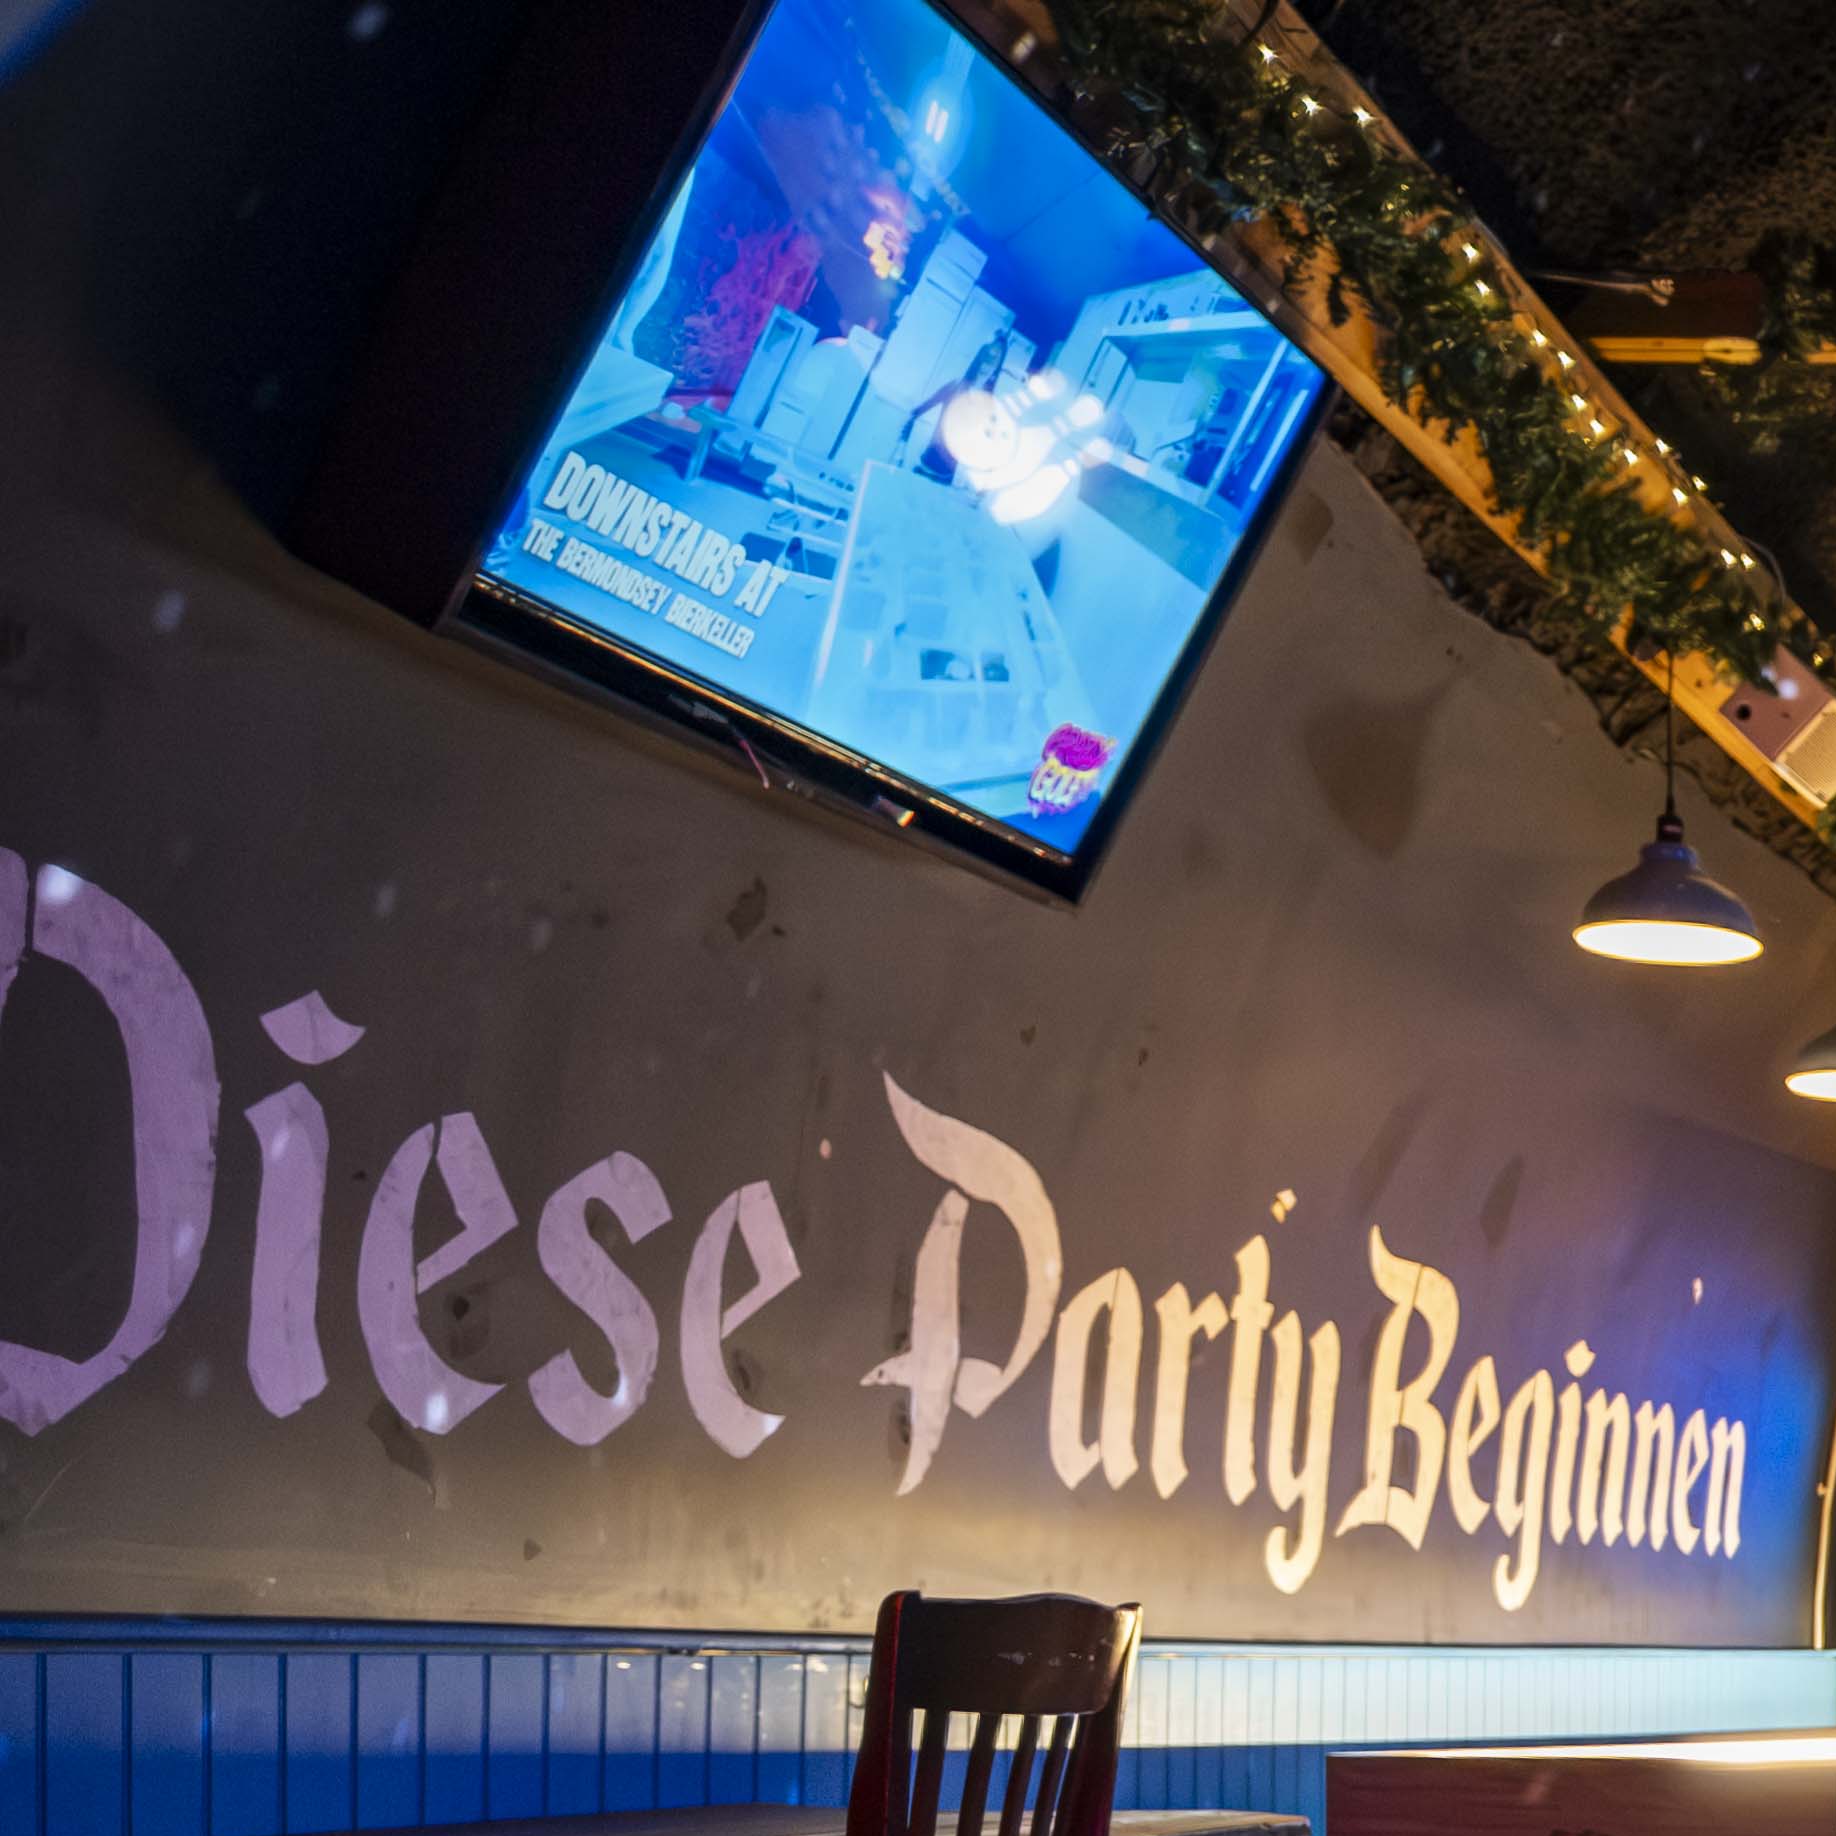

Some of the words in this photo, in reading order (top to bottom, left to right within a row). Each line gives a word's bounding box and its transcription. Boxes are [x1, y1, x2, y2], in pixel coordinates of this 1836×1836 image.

[523, 518, 565, 563] THE
[556, 537, 673, 616] BERMONDSEY
[543, 451, 747, 598] DOWNSTAIRS
[734, 559, 790, 619] AT
[860, 1070, 1341, 1594] Party
[1335, 1225, 1746, 1611] Beginnen
